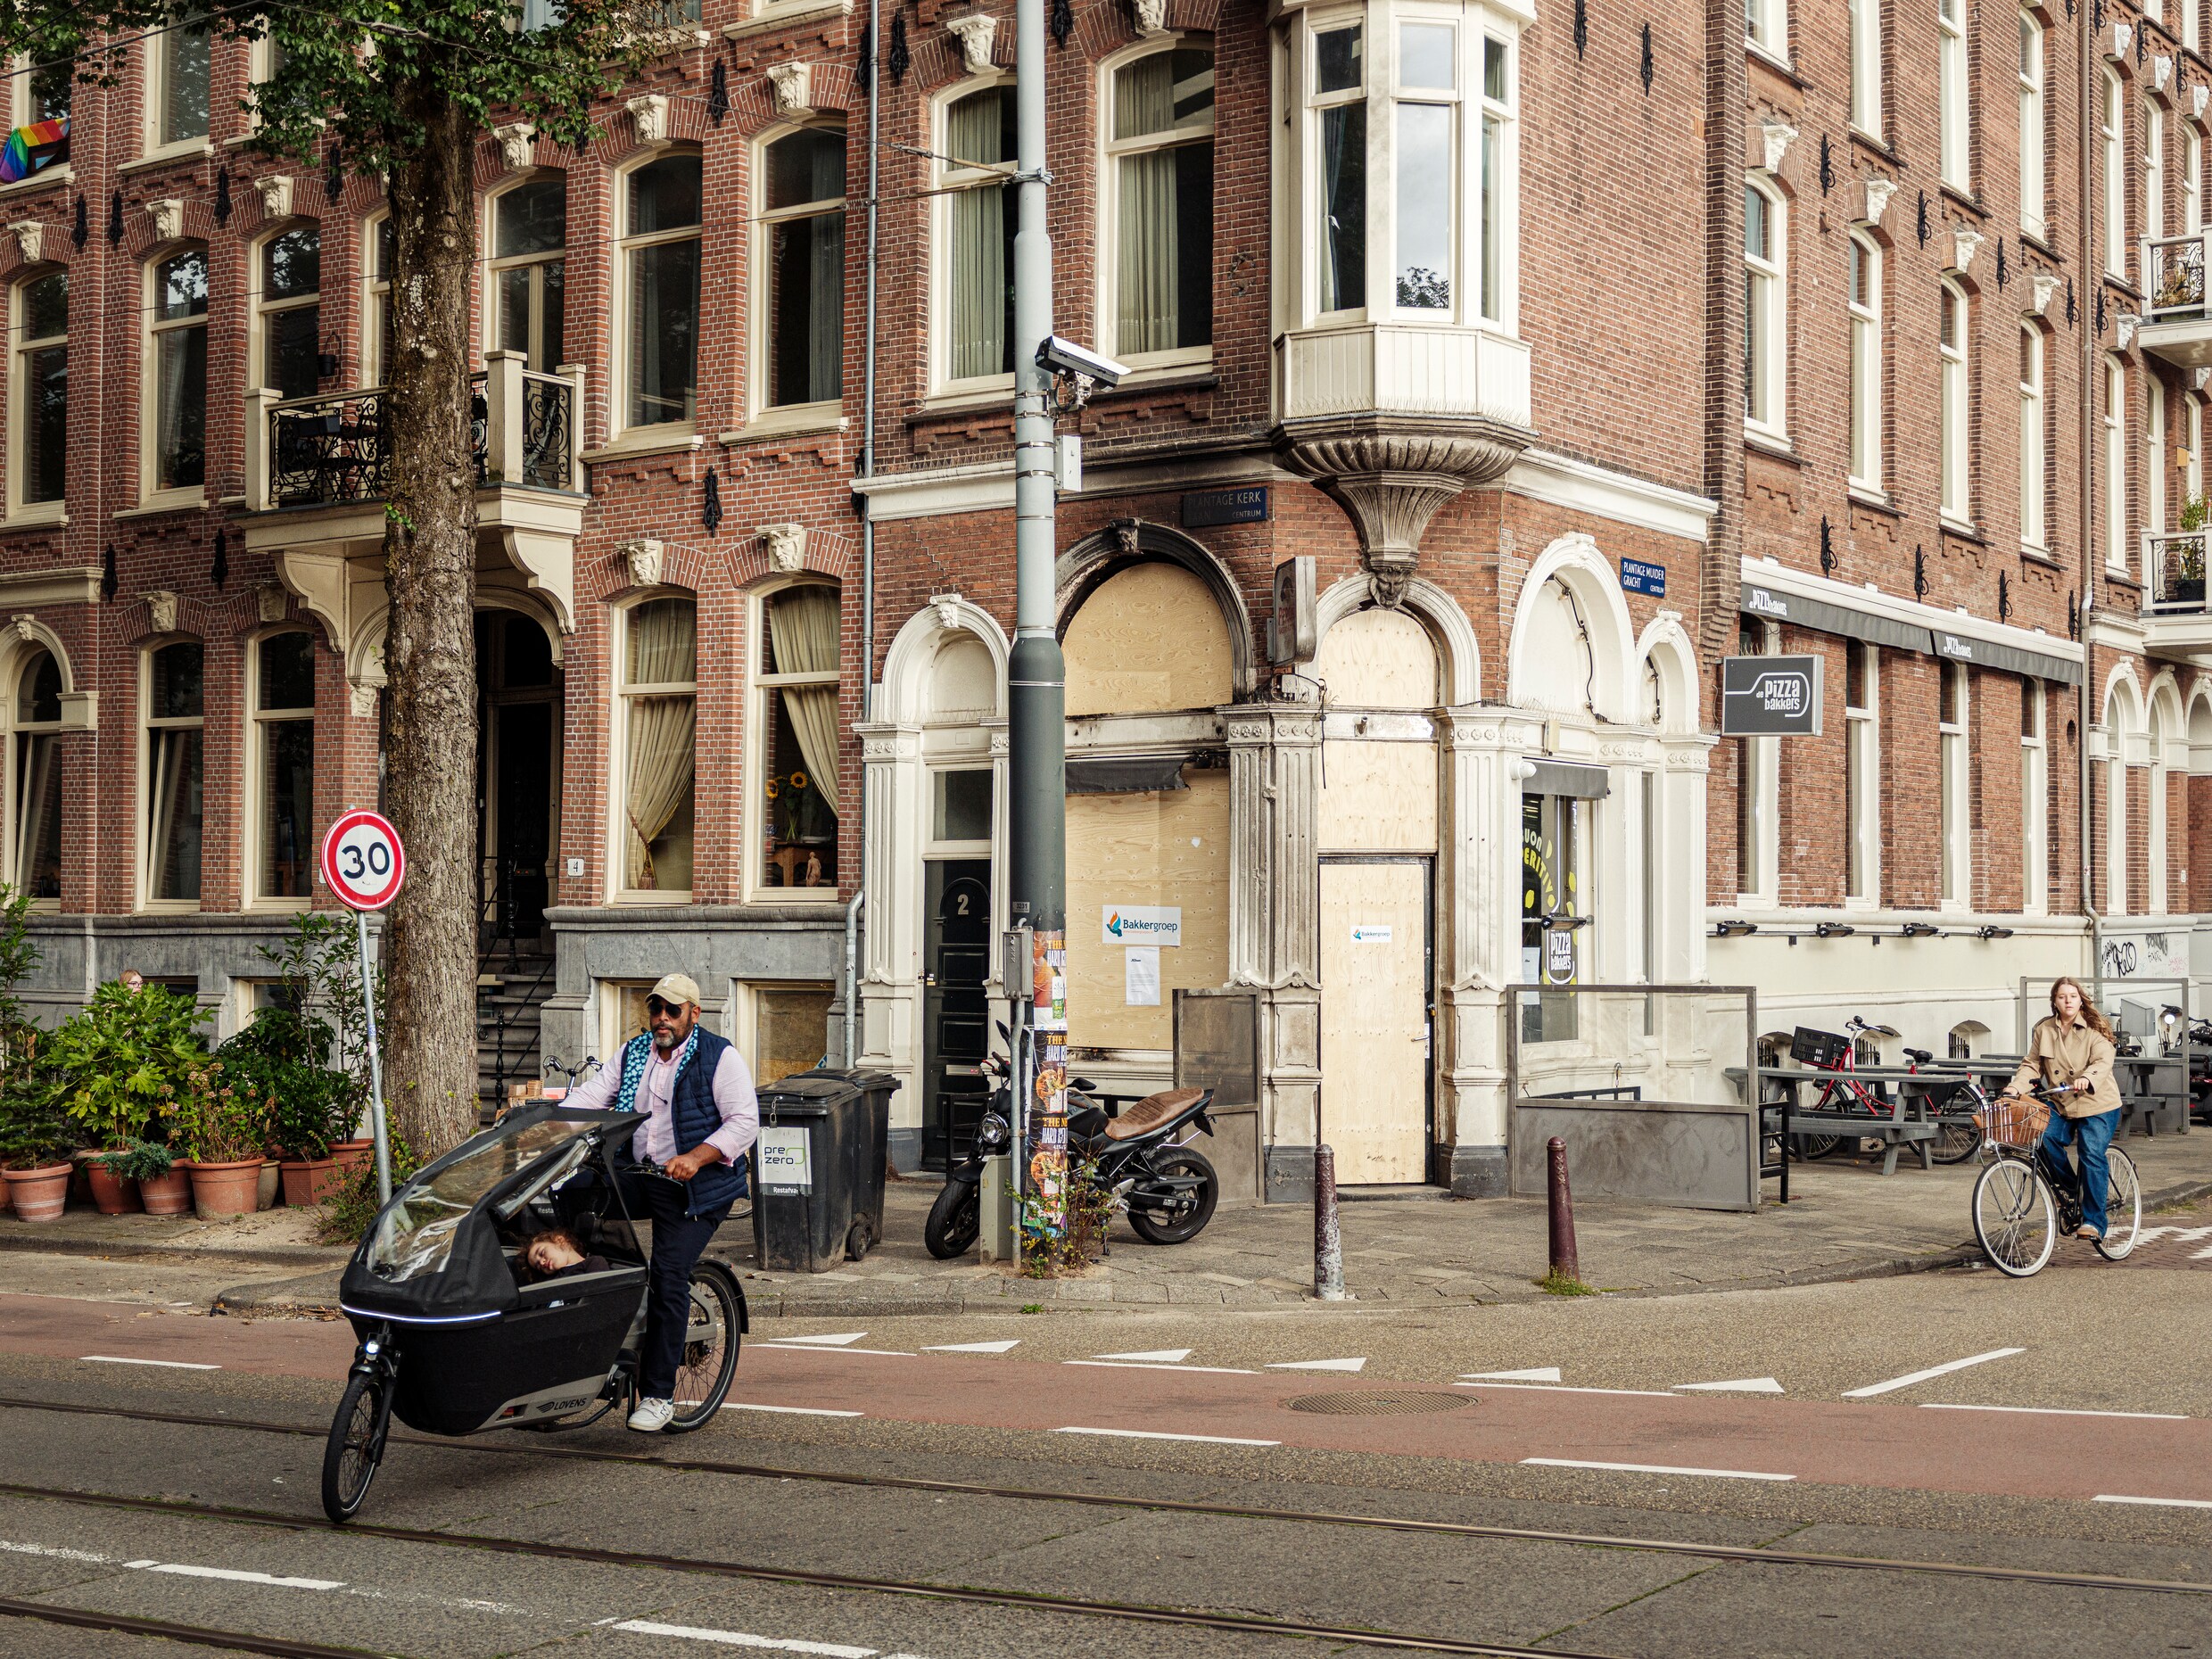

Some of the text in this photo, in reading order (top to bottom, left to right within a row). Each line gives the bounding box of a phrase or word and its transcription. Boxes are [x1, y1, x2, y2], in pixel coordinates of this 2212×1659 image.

[1188, 491, 1261, 508] PLANTAGE KERK
[1233, 508, 1261, 519] CENTRUM
[1623, 561, 1664, 581] PLANTAGE MUIDER
[1623, 574, 1641, 589] GRACHT
[1756, 679, 1801, 698] de pizza
[1764, 697, 1801, 710] bakkers
[1522, 828, 1542, 852] UON
[341, 841, 390, 879] 30
[573, 861, 579, 873] 4
[957, 894, 970, 915] 2
[1123, 919, 1178, 933] Bakkergroep
[1550, 932, 1571, 955] pizza
[1550, 955, 1572, 970] bakkers
[1047, 1035, 1062, 1045] THE
[1043, 1117, 1060, 1127] THE
[1042, 1127, 1057, 1143] HARD
[764, 1147, 785, 1156] pre
[765, 1157, 794, 1165] zero
[554, 1398, 587, 1410] LOVENS
